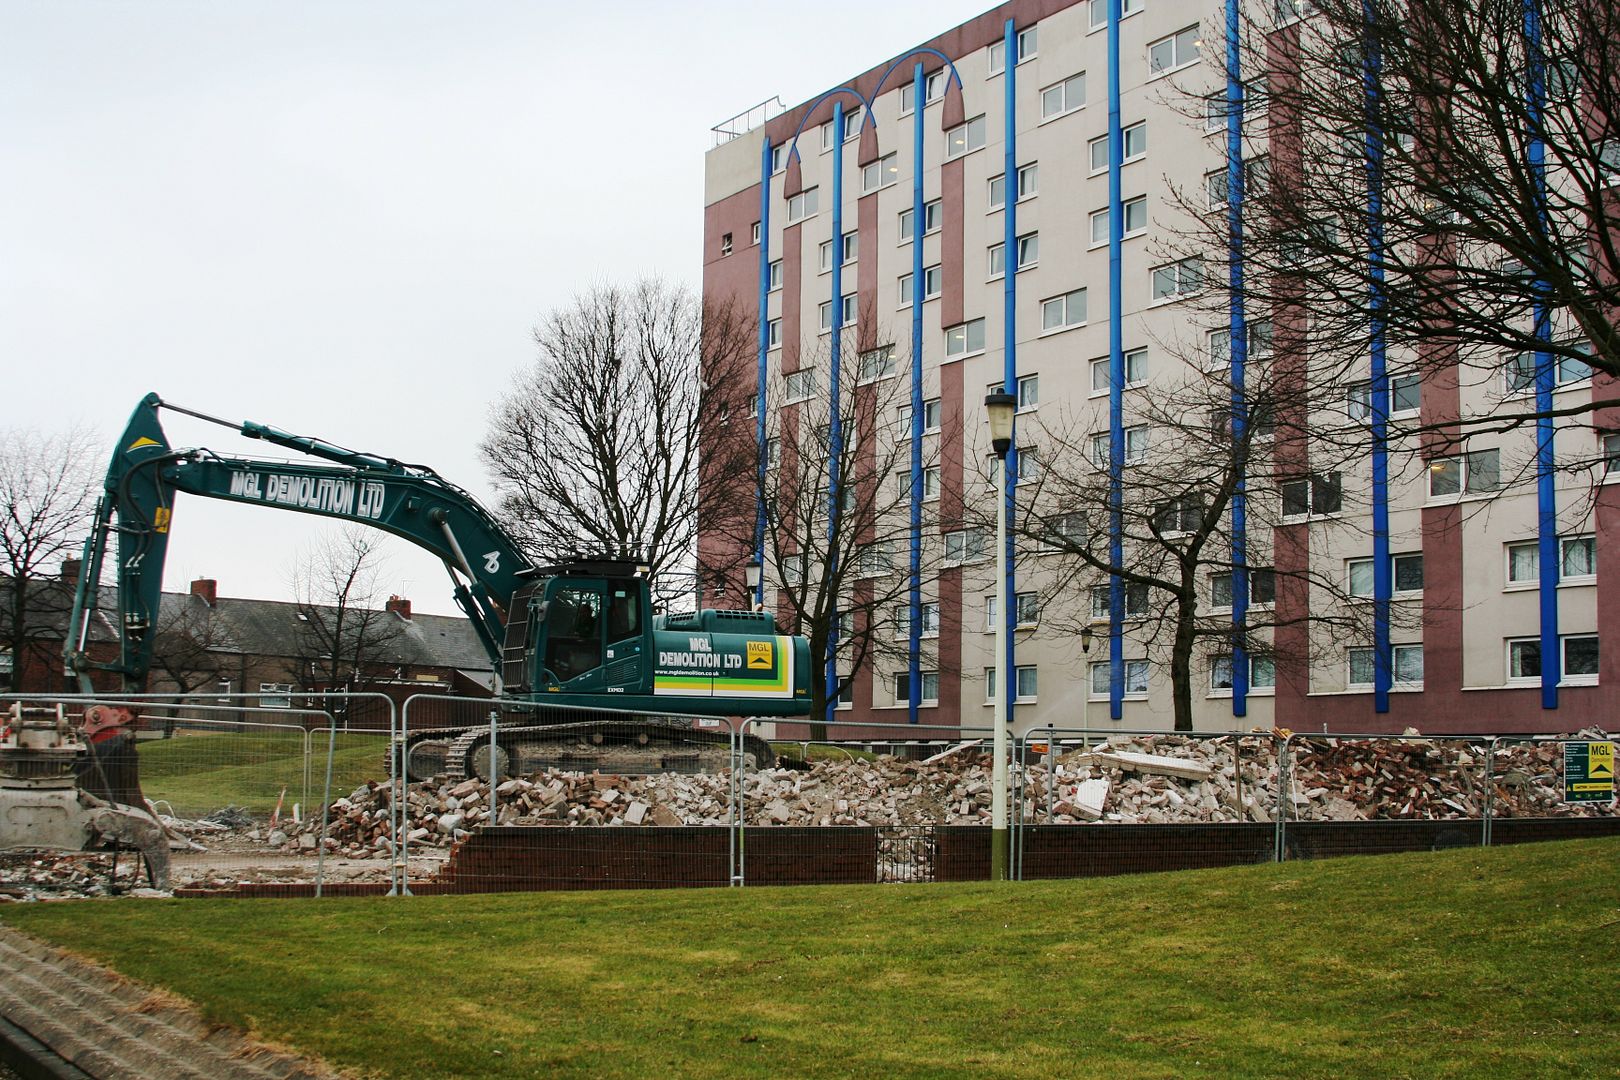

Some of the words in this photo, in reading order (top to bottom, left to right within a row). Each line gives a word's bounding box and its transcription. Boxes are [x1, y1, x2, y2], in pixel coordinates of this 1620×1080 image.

[230, 471, 262, 499] MGL
[266, 474, 356, 515] DEMOLITION
[357, 479, 385, 519] LTD
[689, 637, 713, 652] MGL
[748, 643, 769, 652] MGL
[659, 651, 721, 668] DEMOLITION
[724, 654, 743, 669] LTD
[654, 669, 720, 677] www.mgldemolition.couk
[1591, 745, 1610, 756] MGL
